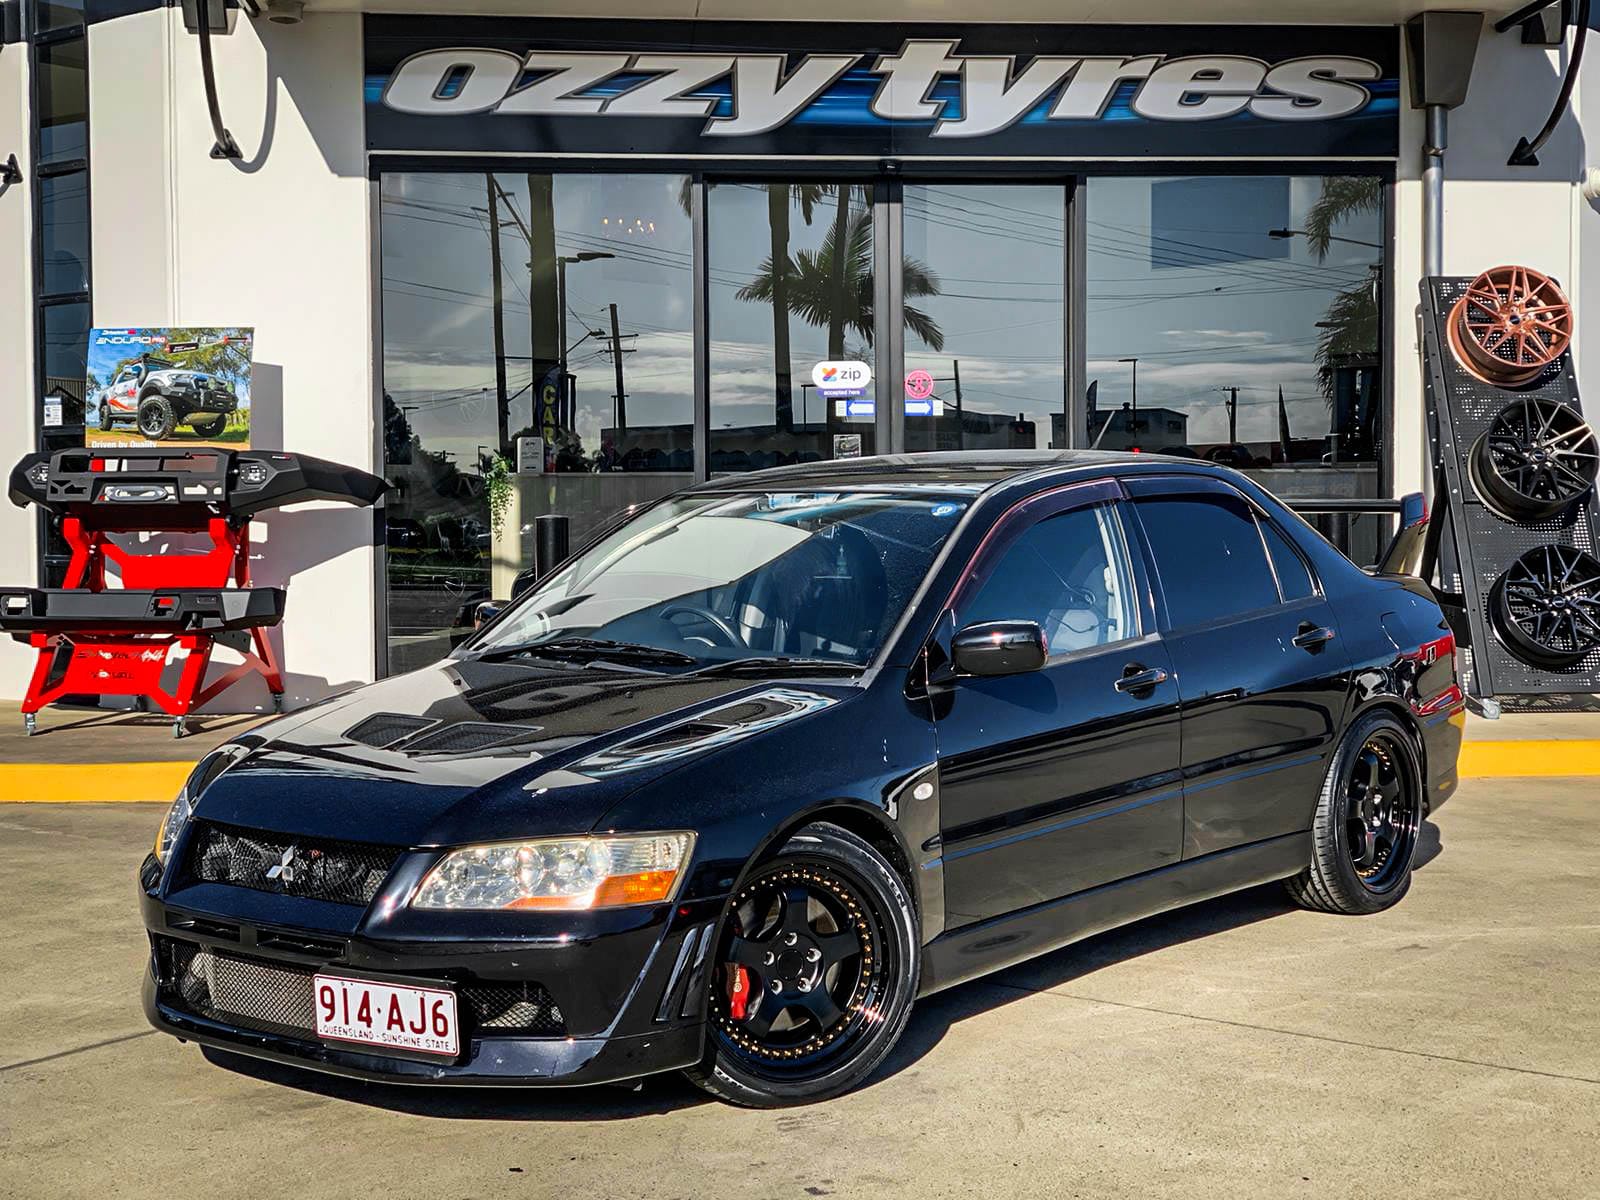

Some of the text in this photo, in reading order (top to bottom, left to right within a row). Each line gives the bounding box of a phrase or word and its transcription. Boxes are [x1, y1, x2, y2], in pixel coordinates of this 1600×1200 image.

[382, 38, 1383, 137] ozzy tyres
[841, 368, 861, 381] zip
[91, 440, 116, 448] Driven
[130, 440, 157, 448] Quality
[323, 1025, 374, 1039] QUEENSLAND
[381, 1033, 421, 1046] SUNSHINE
[425, 1038, 449, 1050] STATE
